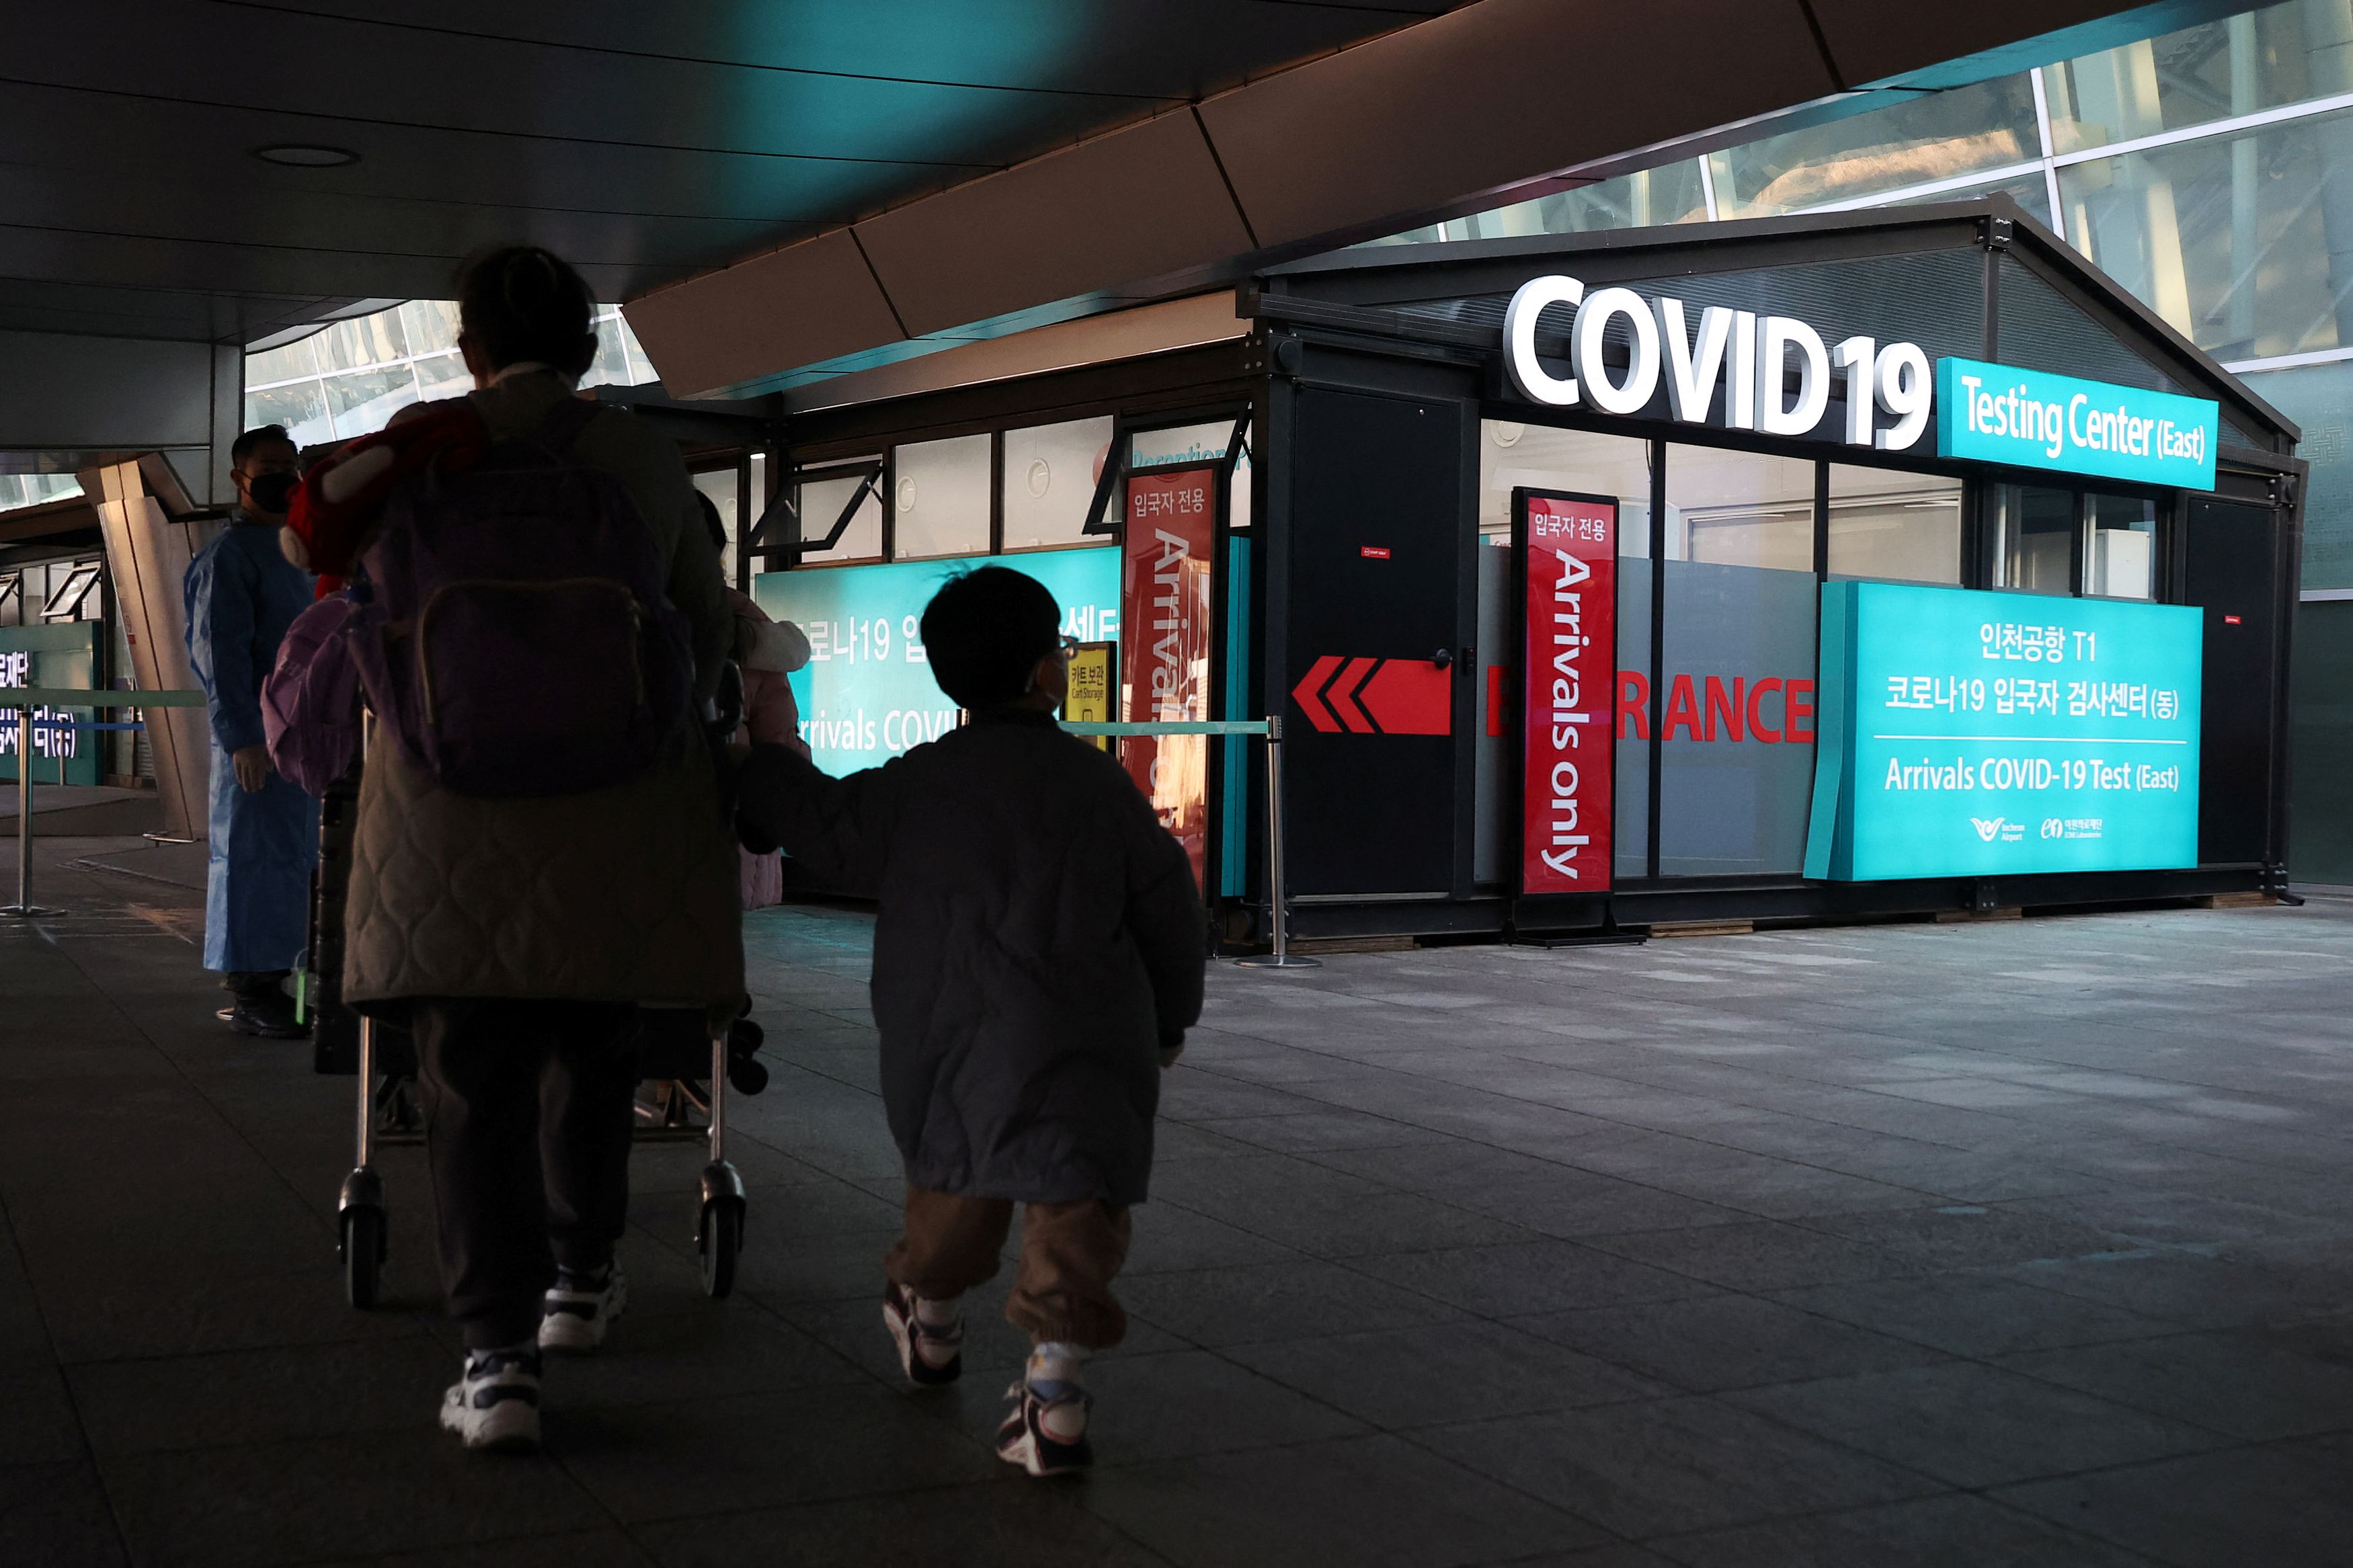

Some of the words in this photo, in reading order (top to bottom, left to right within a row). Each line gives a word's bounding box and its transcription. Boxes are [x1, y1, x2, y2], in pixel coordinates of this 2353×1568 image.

[1962, 376, 2063, 458] Testing
[2069, 393, 2154, 456] Center
[2157, 423, 2205, 460] (East)
[1134, 491, 1174, 518] 입국자
[1179, 487, 1205, 513] 전용
[1534, 513, 1576, 540] 입국자
[1579, 518, 1606, 542] 전용
[796, 616, 891, 665] 로나19
[1150, 528, 1189, 741] Arrival
[1552, 548, 1591, 749] Arrivals
[1980, 622, 2065, 663] 인천공항
[2072, 630, 2096, 662] T1
[1486, 665, 1814, 743] ERANCE
[1885, 676, 1985, 713] 코로나19
[1994, 679, 2059, 715] 입국자
[797, 708, 876, 751] rrivals
[1884, 757, 1975, 791] Arrivals
[1980, 758, 2084, 791] COVID-19
[2089, 759, 2131, 790] Test
[2137, 764, 2179, 792] (East)
[1541, 761, 1590, 880] only
